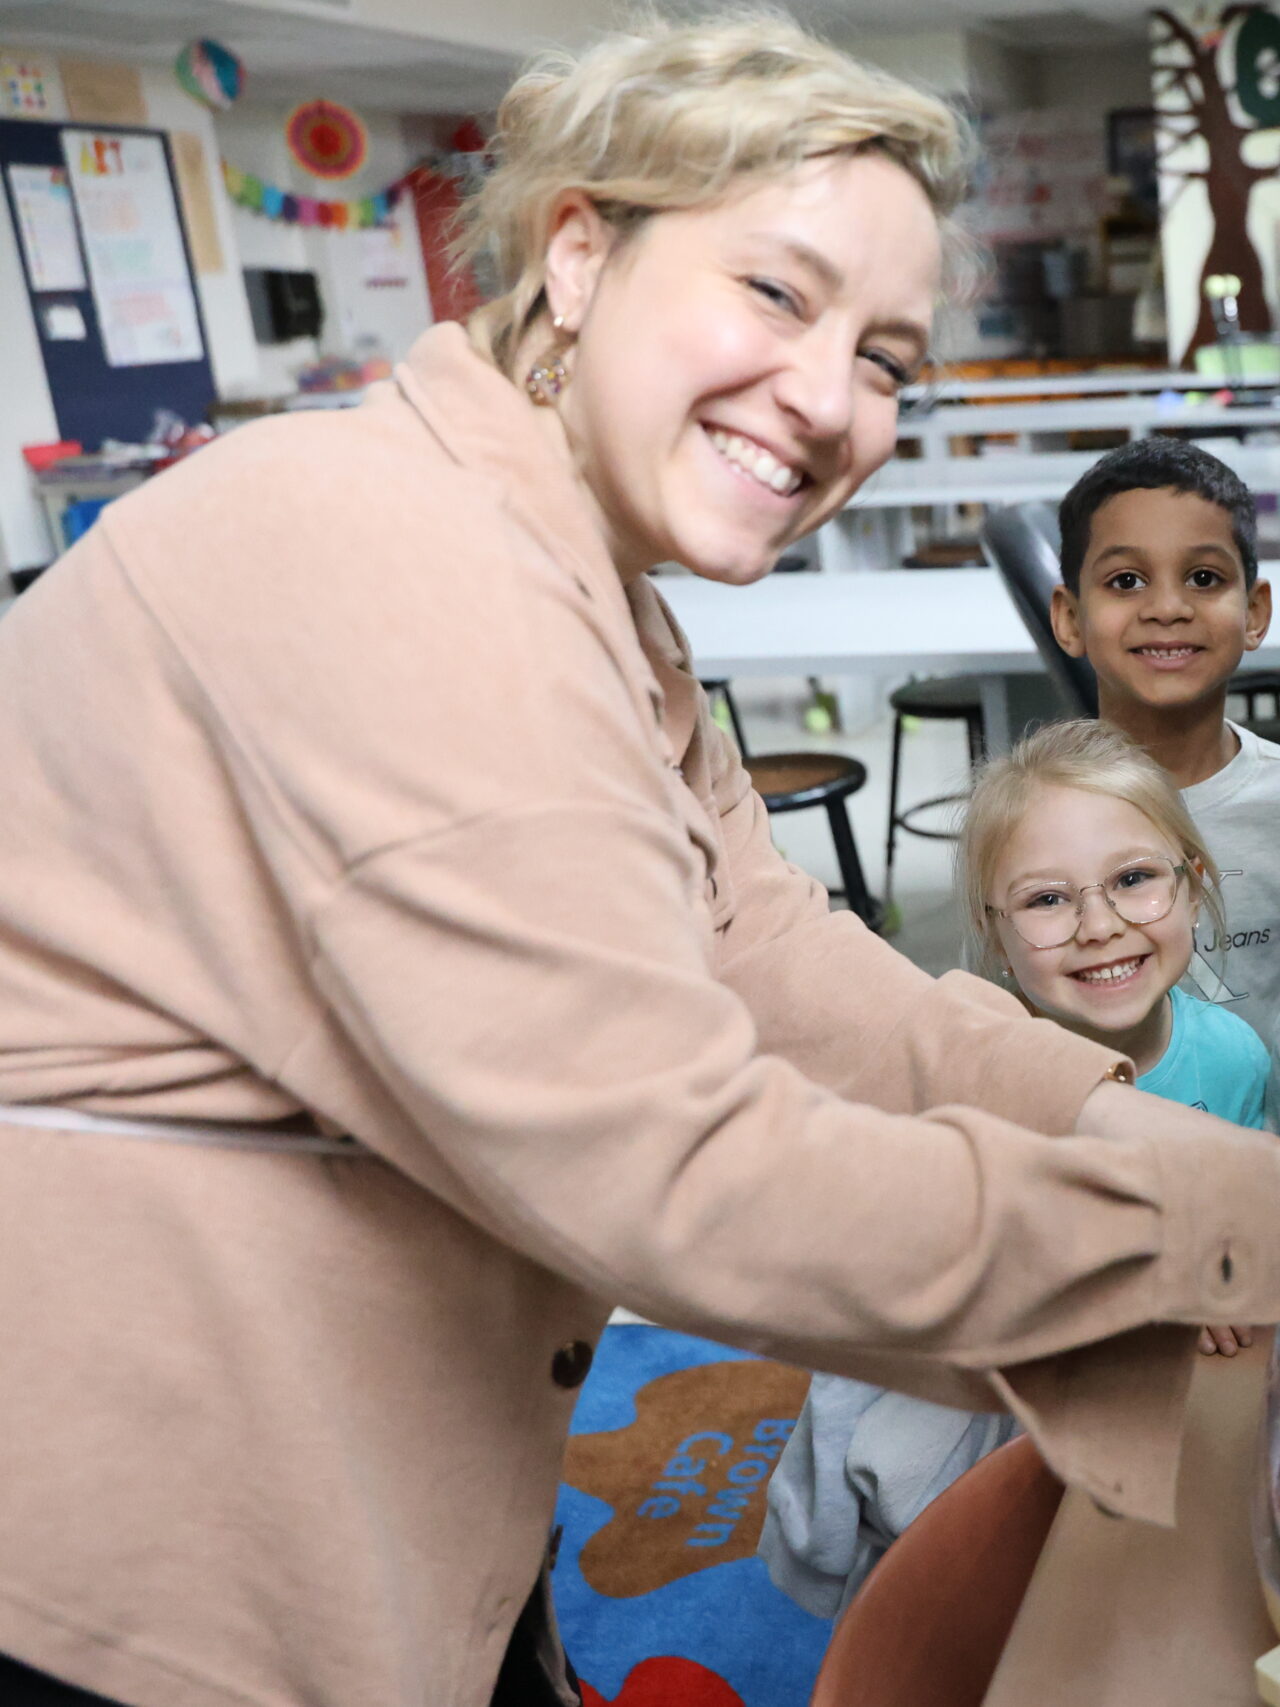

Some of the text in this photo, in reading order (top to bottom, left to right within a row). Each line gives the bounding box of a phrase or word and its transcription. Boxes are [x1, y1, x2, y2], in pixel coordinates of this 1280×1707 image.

[1203, 928, 1271, 953] Jeans
[636, 1431, 734, 1519] Cafe
[685, 1418, 798, 1547] Brown
